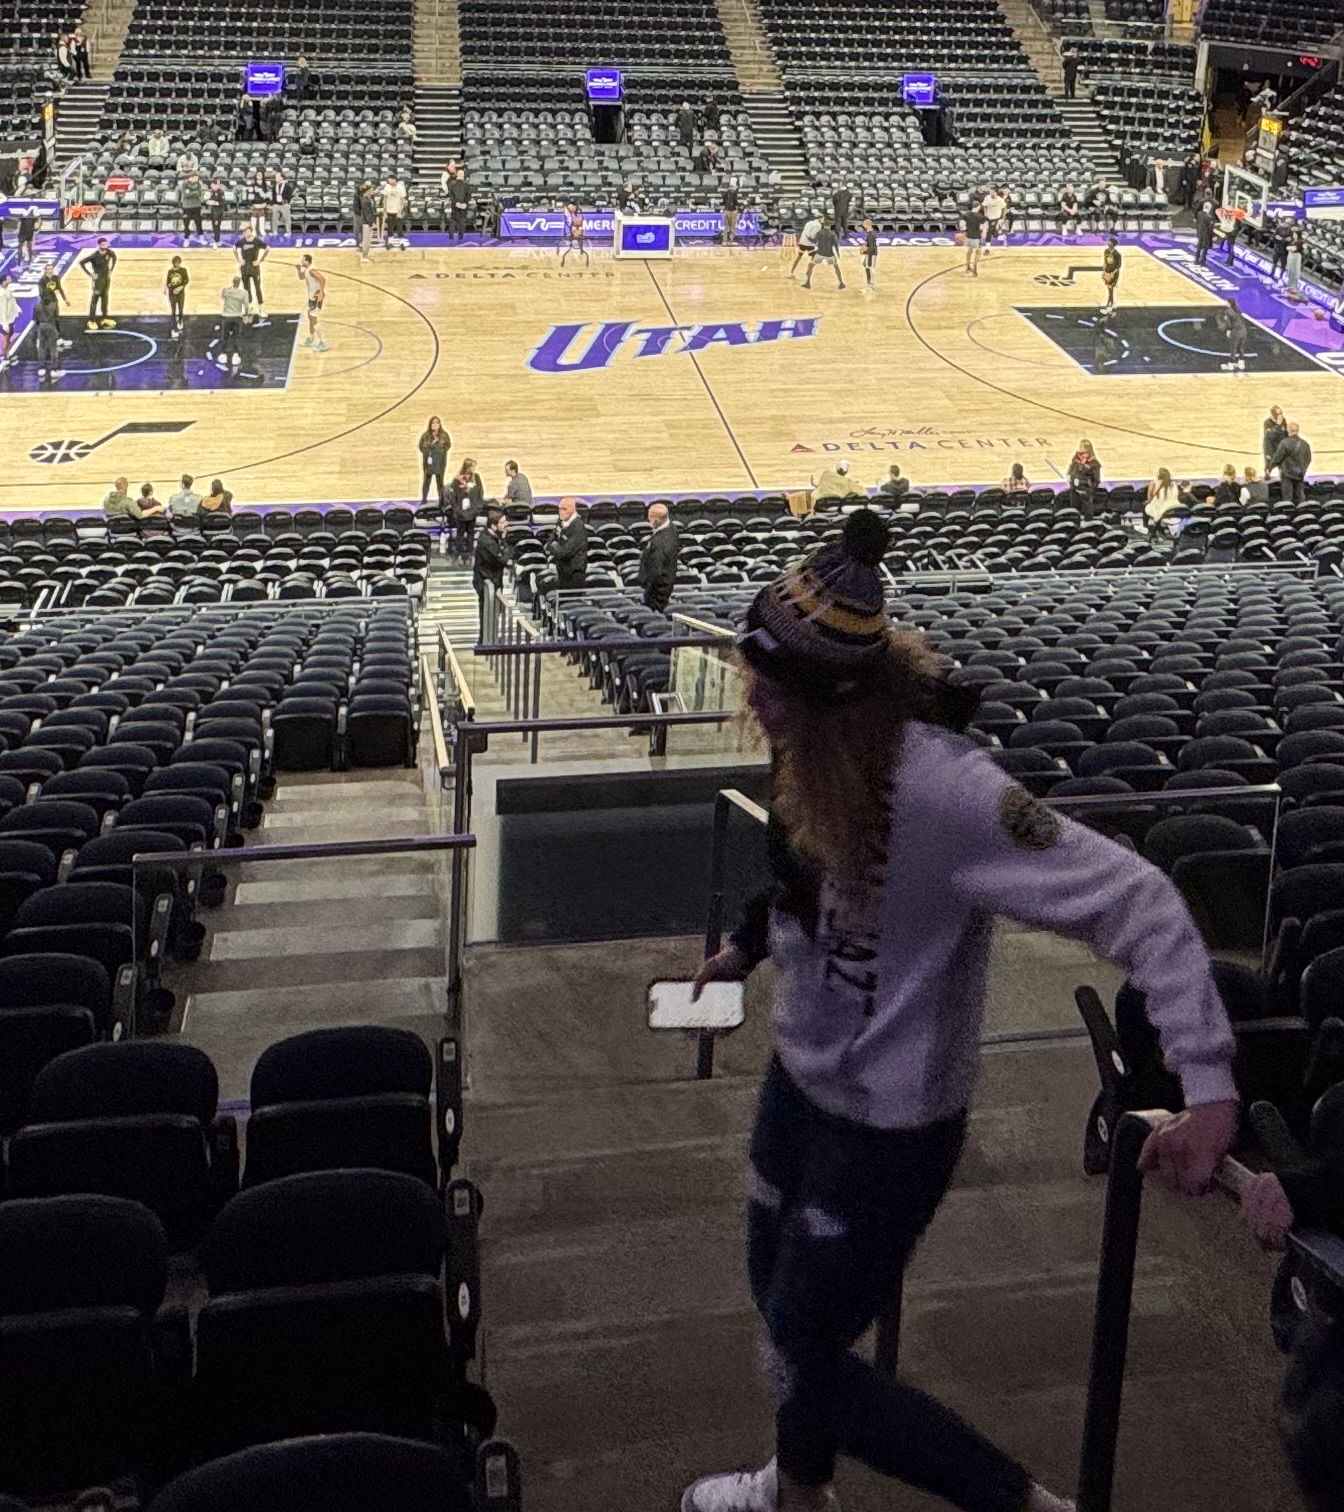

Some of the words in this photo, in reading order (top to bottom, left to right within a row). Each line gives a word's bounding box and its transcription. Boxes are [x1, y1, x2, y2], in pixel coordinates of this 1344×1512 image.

[675, 221, 719, 231] CREDIT
[876, 238, 956, 246] PACS
[526, 317, 822, 373] UTAH
[822, 440, 927, 452] DELTA
[937, 437, 1053, 450] CENTER
